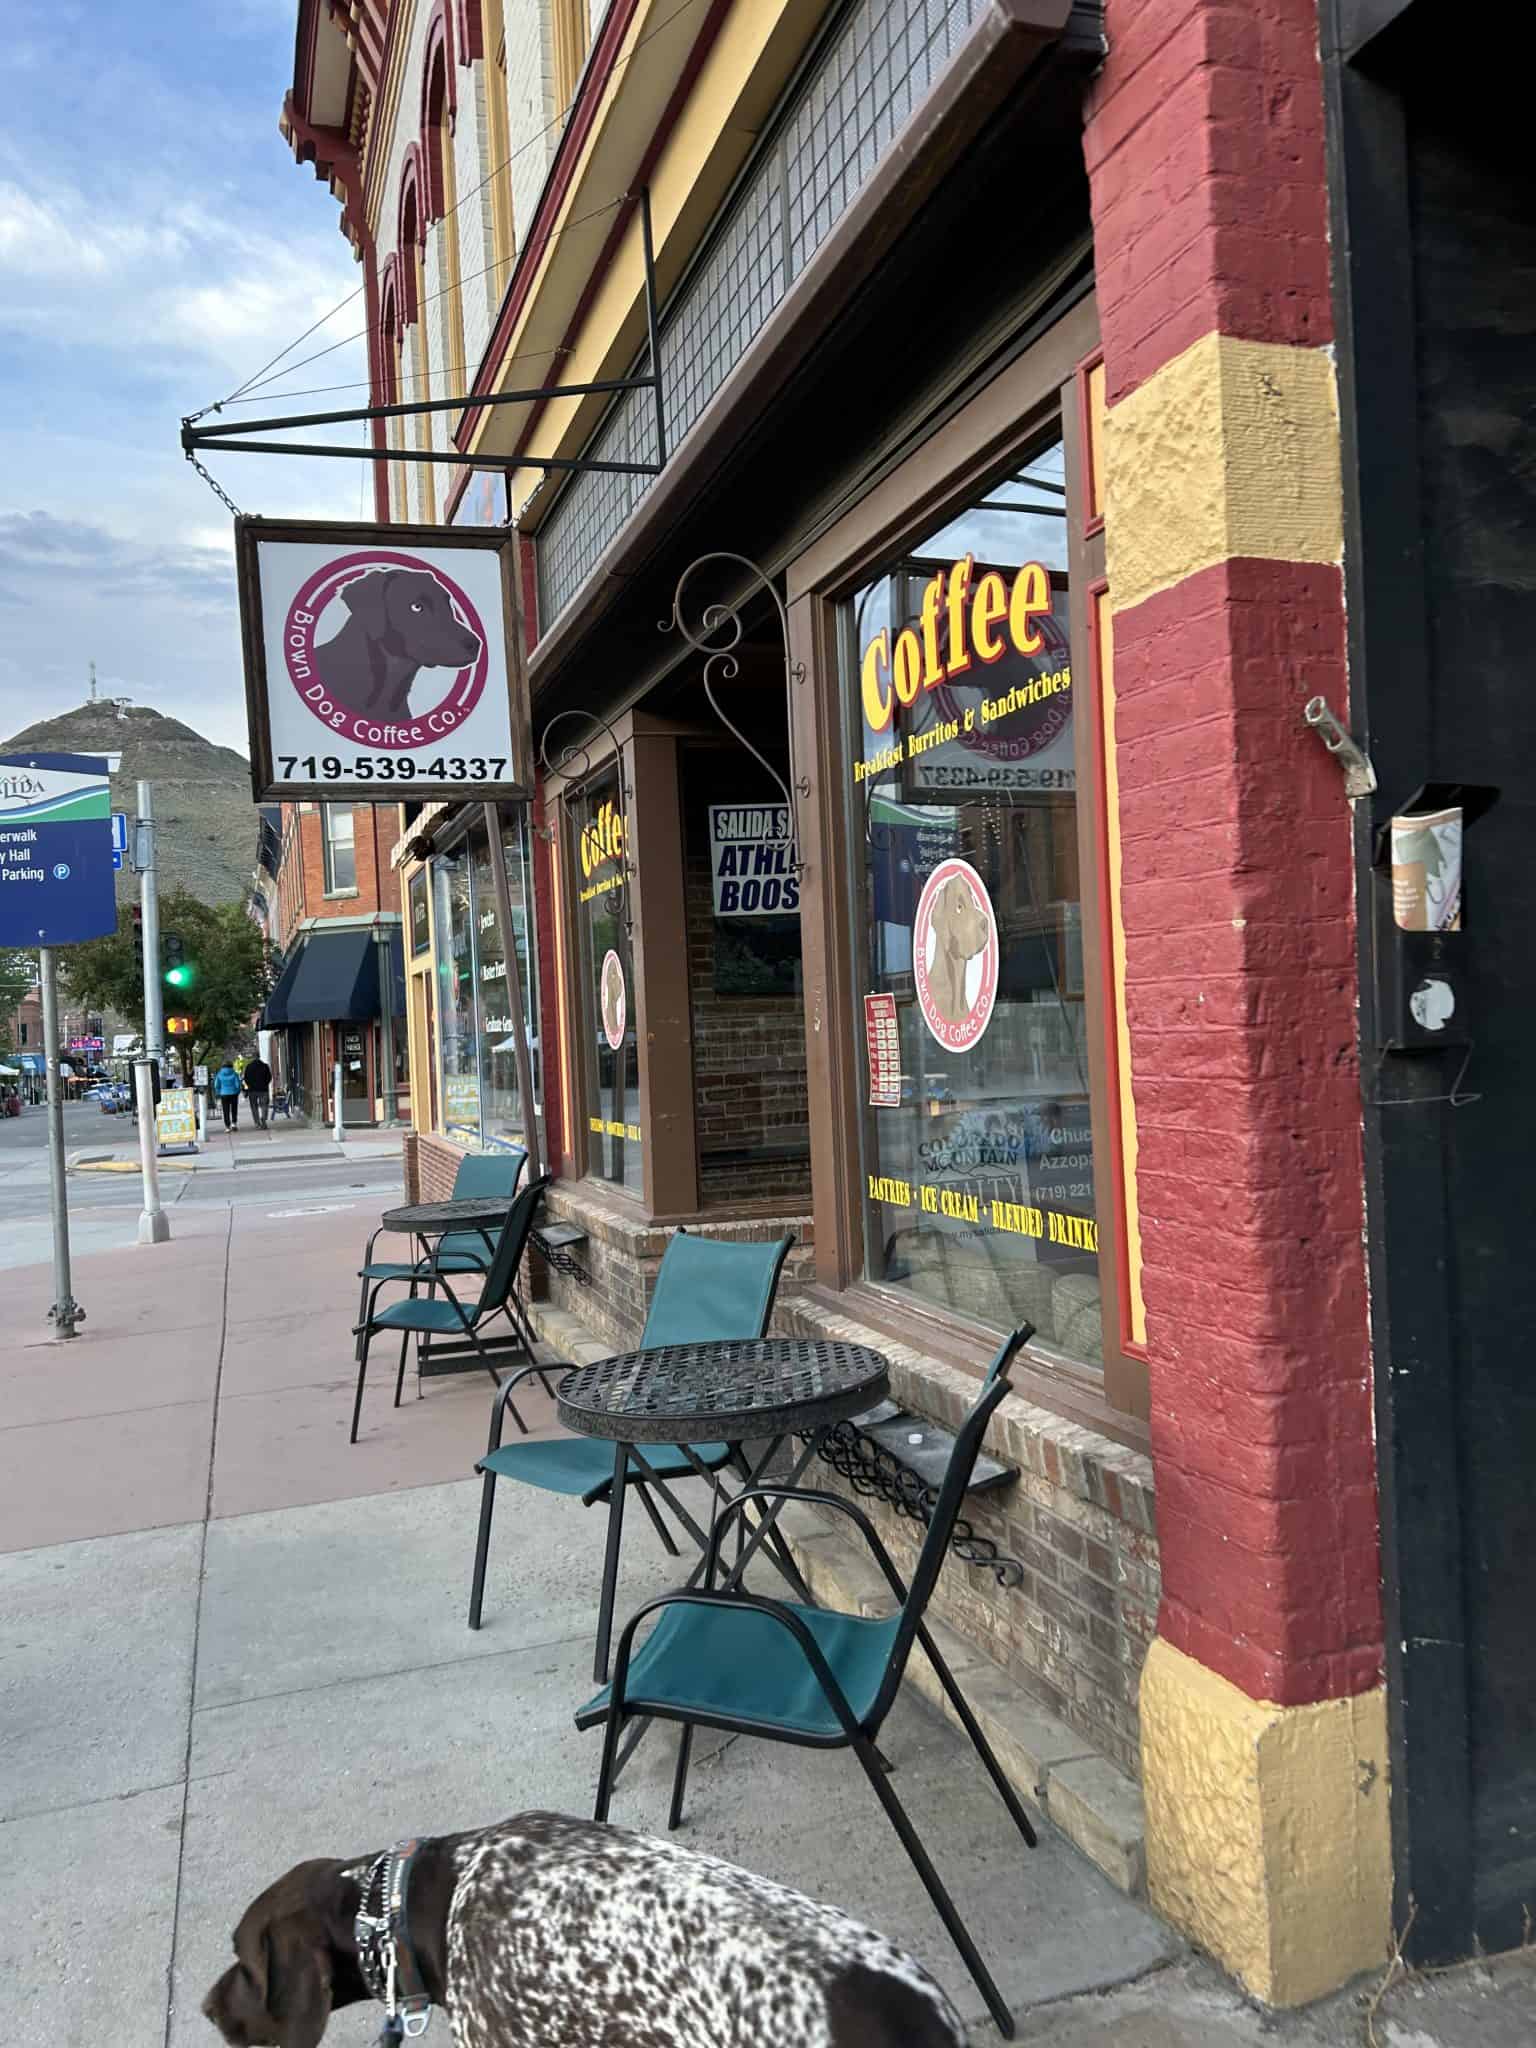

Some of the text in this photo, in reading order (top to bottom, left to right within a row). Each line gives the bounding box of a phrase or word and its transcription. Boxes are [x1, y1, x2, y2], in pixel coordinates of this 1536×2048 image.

[862, 553, 1051, 734] Coffee
[290, 610, 463, 744] Brown Dog Coffee Co.
[854, 667, 1072, 783] Breakfast Burritos & Sandwiches
[278, 756, 507, 780] 719-539-4337
[717, 810, 773, 839] SALIDA
[2, 867, 44, 881] Parking
[9, 848, 30, 861] Hall
[720, 878, 800, 911] BOOS
[917, 947, 930, 1004] Brown
[929, 1004, 947, 1038] Dog
[949, 1019, 977, 1041] Coffee
[868, 1175, 911, 1207] PASTRIES
[920, 1184, 938, 1213] ICE
[941, 1190, 980, 1223] CREAM
[991, 1199, 1044, 1239] BLENDED
